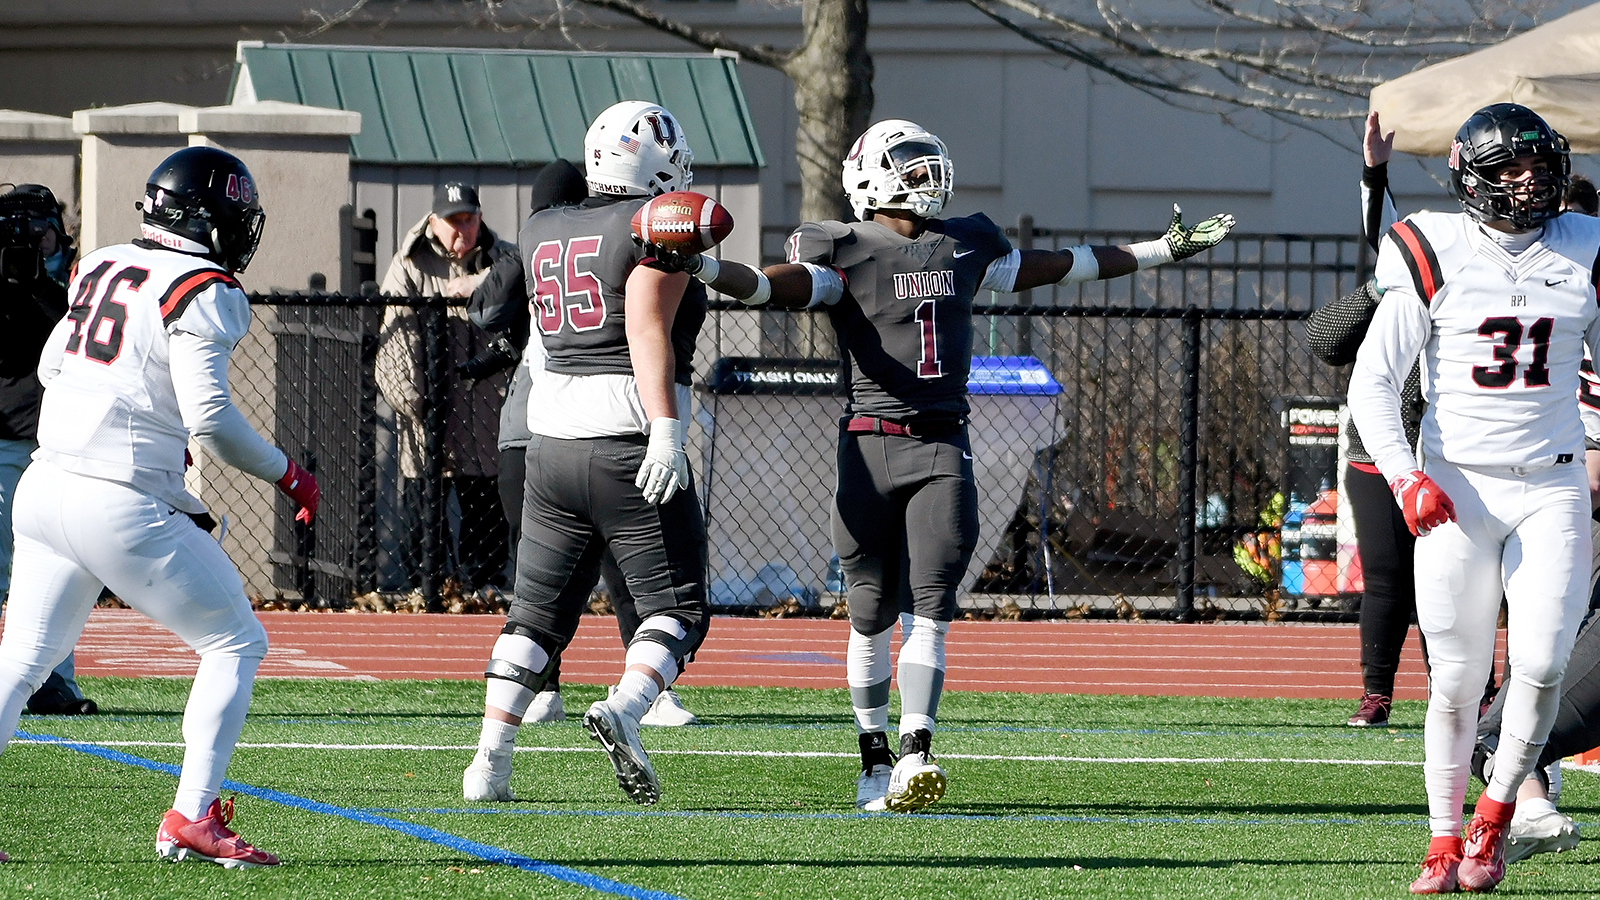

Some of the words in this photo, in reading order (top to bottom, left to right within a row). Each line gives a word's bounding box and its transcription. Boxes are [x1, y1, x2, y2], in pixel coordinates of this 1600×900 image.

[644, 114, 677, 149] U
[225, 173, 252, 204] 46
[656, 204, 692, 216] Wilson
[789, 231, 801, 264] 1
[531, 234, 607, 335] 65
[893, 270, 956, 300] UNION
[1510, 294, 1527, 307] RPI
[64, 260, 152, 367] 46
[914, 299, 943, 380] 1
[1471, 316, 1555, 390] 31
[733, 370, 791, 384] TRASH
[793, 371, 839, 384] ONLY
